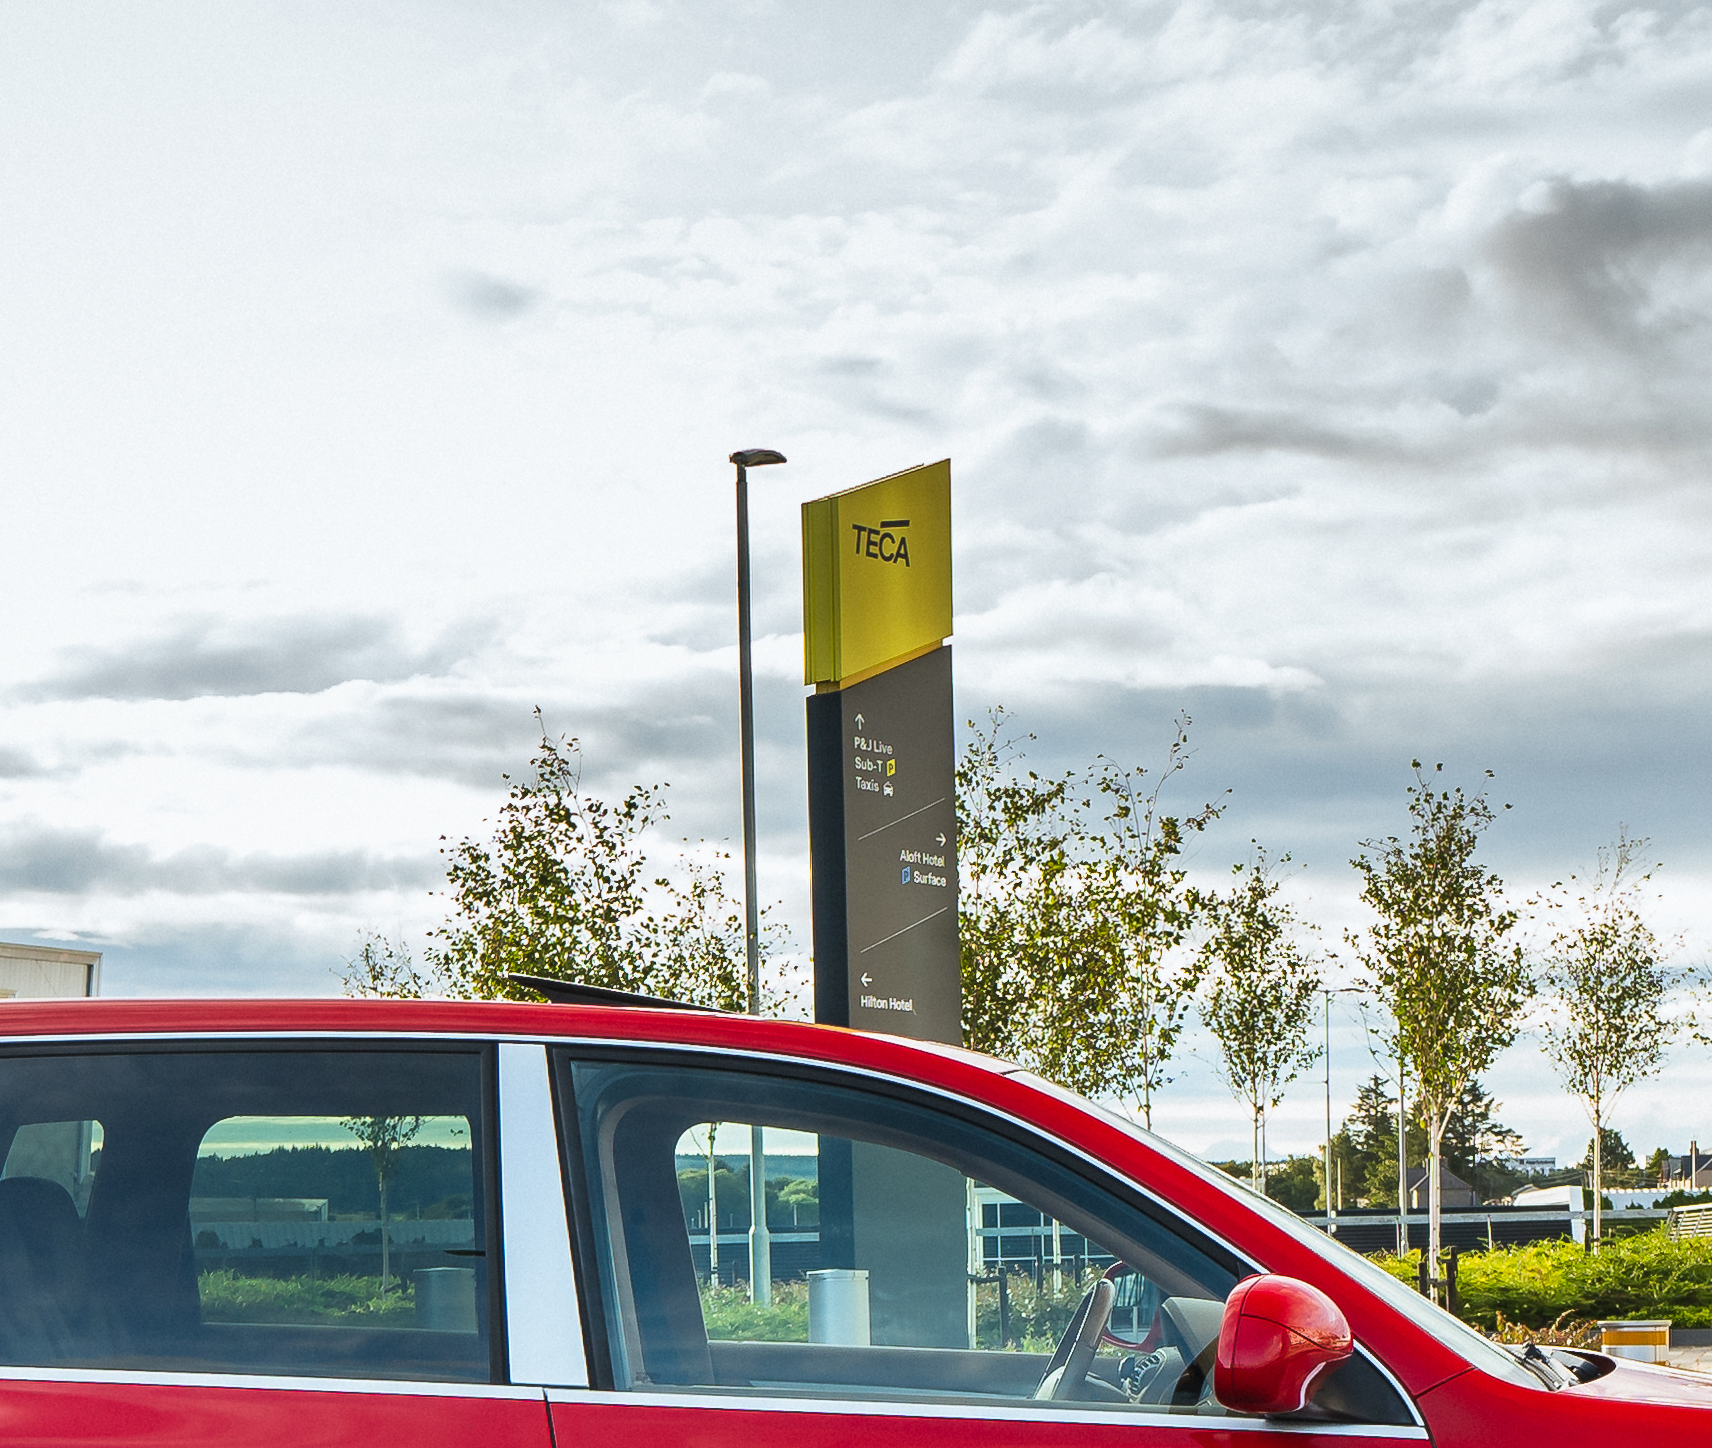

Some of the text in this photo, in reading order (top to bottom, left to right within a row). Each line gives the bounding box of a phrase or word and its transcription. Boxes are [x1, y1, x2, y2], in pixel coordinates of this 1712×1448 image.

[852, 523, 911, 568] TECA
[854, 736, 893, 755] P&J Live
[854, 756, 884, 773] Sub-T
[855, 776, 880, 792] Taxis
[899, 849, 946, 868] Aloft Hotel
[913, 870, 947, 888] Surface
[860, 994, 913, 1012] Hilton Hotel
